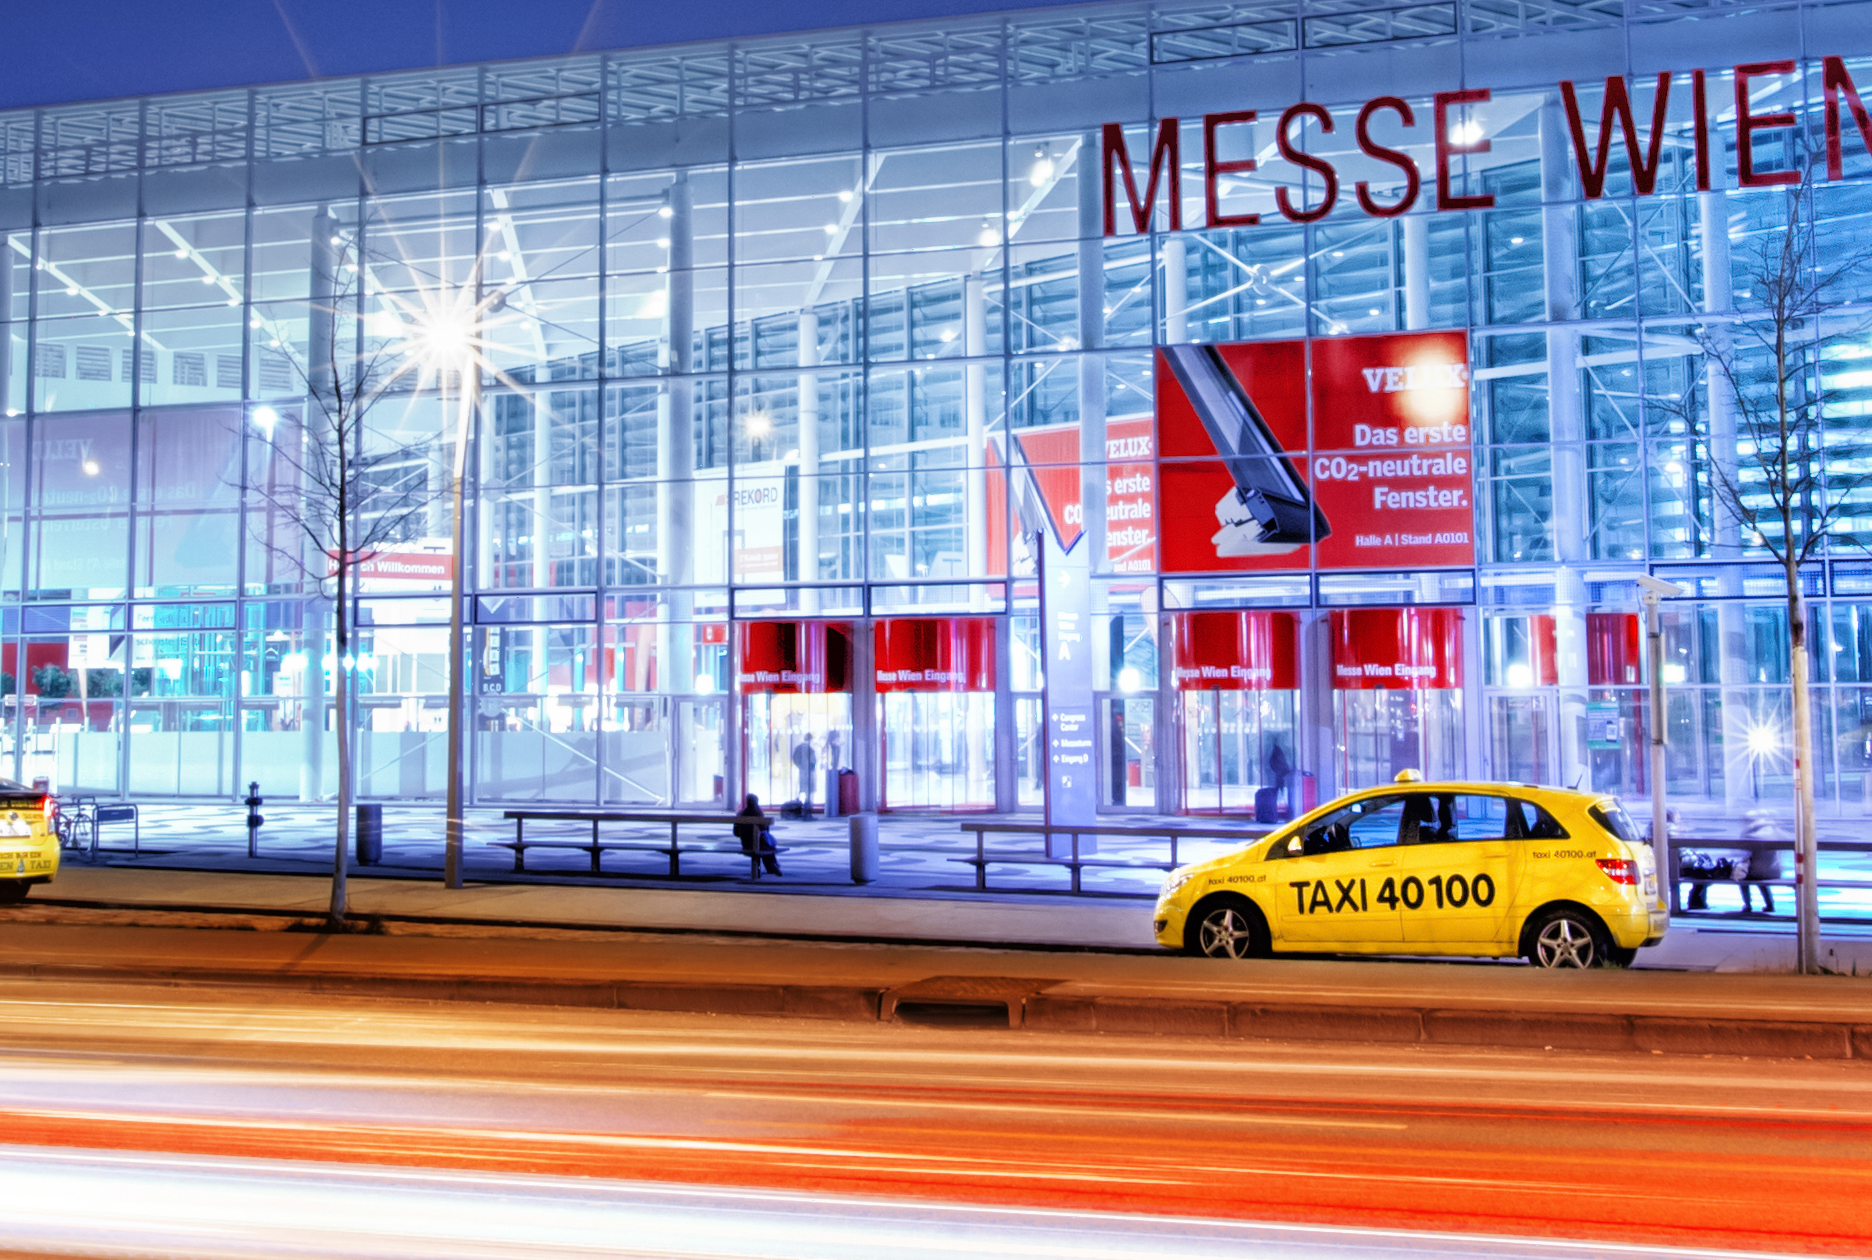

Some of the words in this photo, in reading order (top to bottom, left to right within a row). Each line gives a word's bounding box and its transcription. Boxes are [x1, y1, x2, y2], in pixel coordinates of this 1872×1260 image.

[1101, 88, 1496, 237] MESSE
[1354, 423, 1398, 446] Das
[1403, 421, 1467, 445] erste
[1106, 436, 1150, 458] ELUX
[1114, 473, 1151, 494] erste
[733, 487, 778, 506] REKORD
[1373, 485, 1468, 510] Fenster.
[1354, 533, 1381, 547] Halle
[1384, 533, 1393, 546] A
[1400, 532, 1432, 546] Stand
[1434, 531, 1469, 545] A0101
[377, 560, 445, 575] Willkommen
[1058, 640, 1071, 661] A
[897, 669, 922, 681] Wien
[924, 669, 963, 684] Eingang
[1201, 665, 1228, 678] Wien
[1230, 664, 1271, 681] Eingang
[1363, 663, 1392, 676] Wien
[1394, 663, 1436, 679] Eingang
[1533, 850, 1550, 859] taxi
[30, 860, 52, 870] TAXI
[1290, 878, 1368, 914] TAXI
[1376, 873, 1496, 911] 40100
